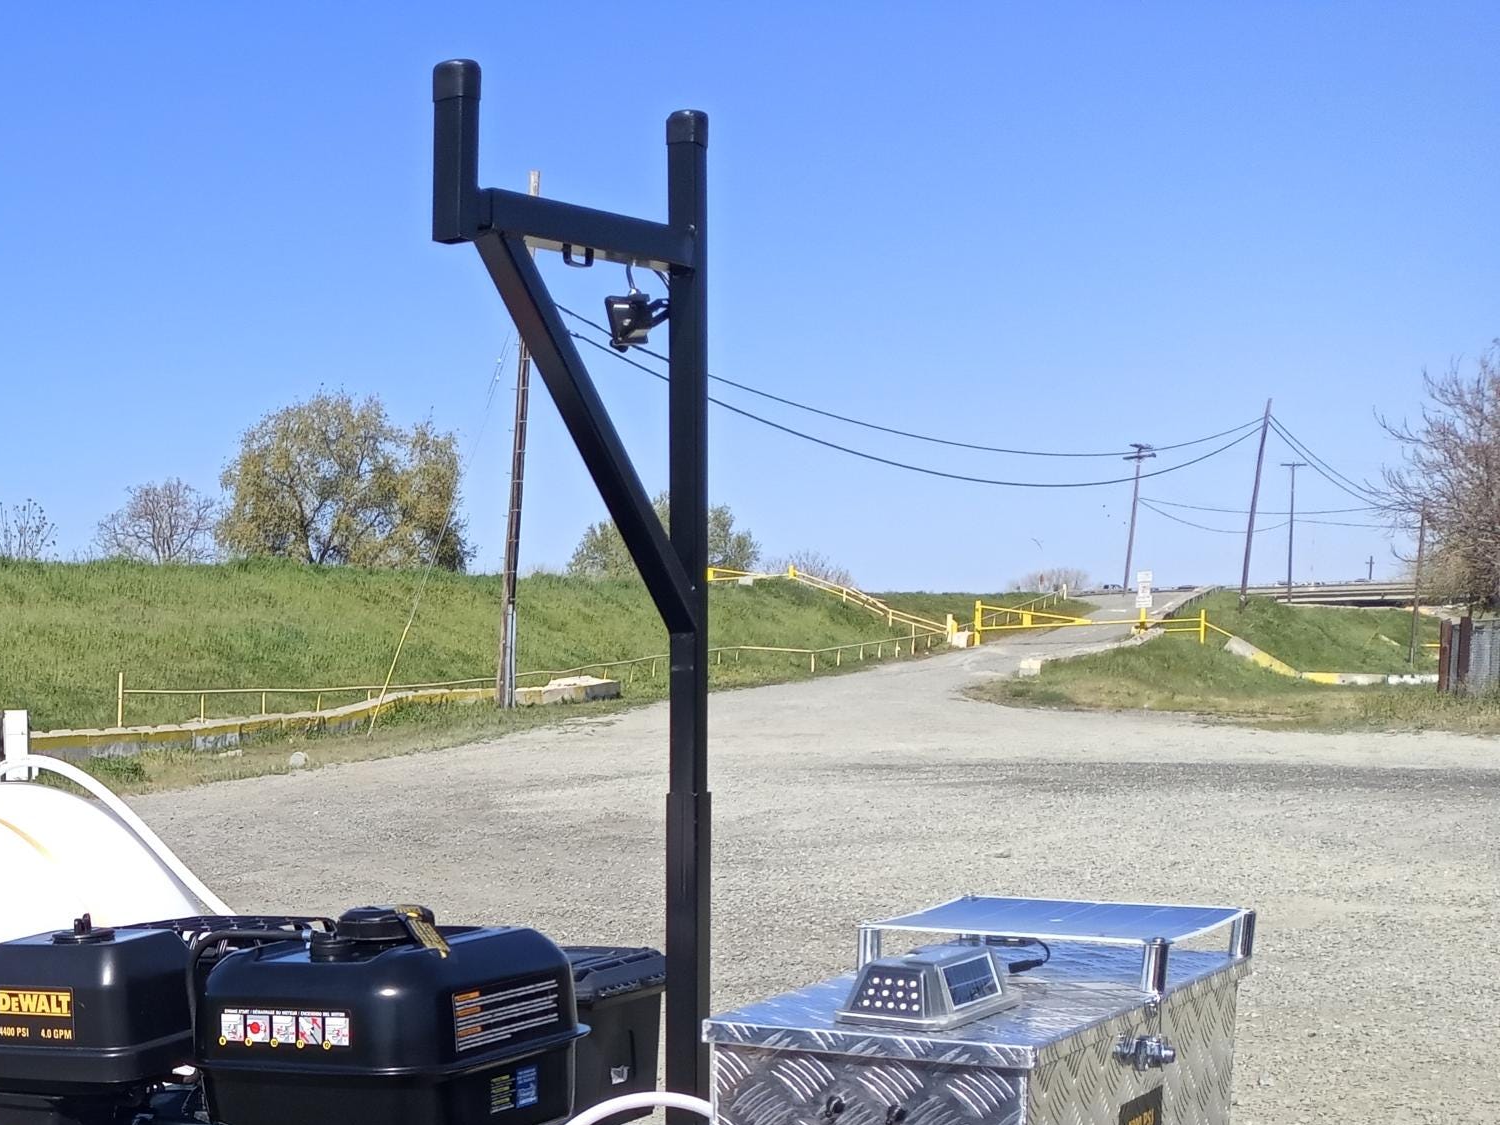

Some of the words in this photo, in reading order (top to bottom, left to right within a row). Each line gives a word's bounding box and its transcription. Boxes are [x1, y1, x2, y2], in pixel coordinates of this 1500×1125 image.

[0, 1026, 15, 1037] 4400
[16, 1026, 30, 1037] PSI
[41, 1028, 52, 1039] 4.0
[53, 1029, 73, 1040] GPM
